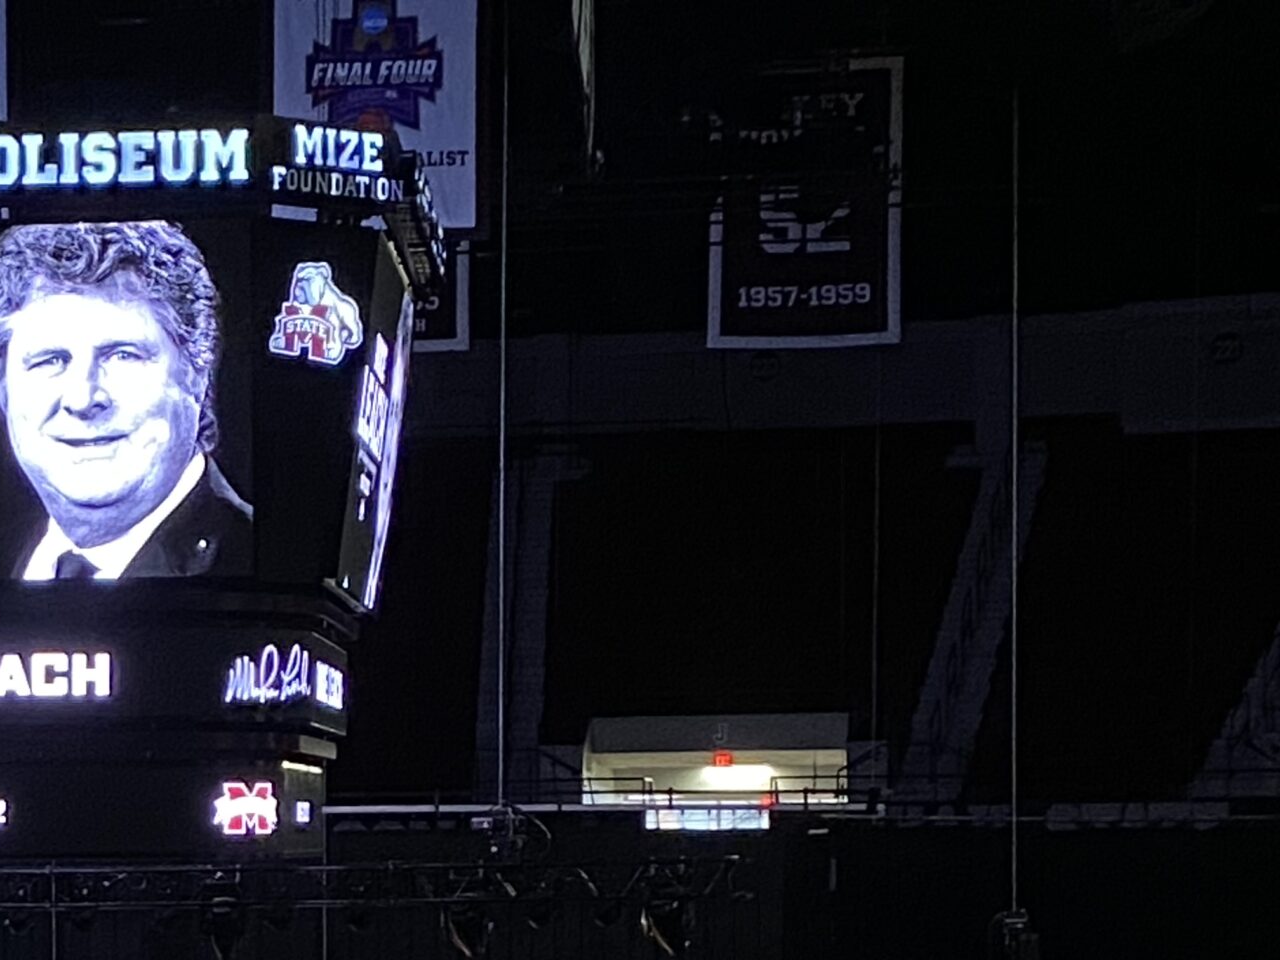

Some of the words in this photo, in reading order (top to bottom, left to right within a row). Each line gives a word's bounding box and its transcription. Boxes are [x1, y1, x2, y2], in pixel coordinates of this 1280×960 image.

[311, 61, 373, 88] FINAL
[376, 59, 438, 86] FOUR
[294, 123, 384, 172] MIZE
[272, 165, 404, 201] FOUNDATION
[737, 282, 872, 308] 1957-1959
[285, 319, 329, 337] STATE
